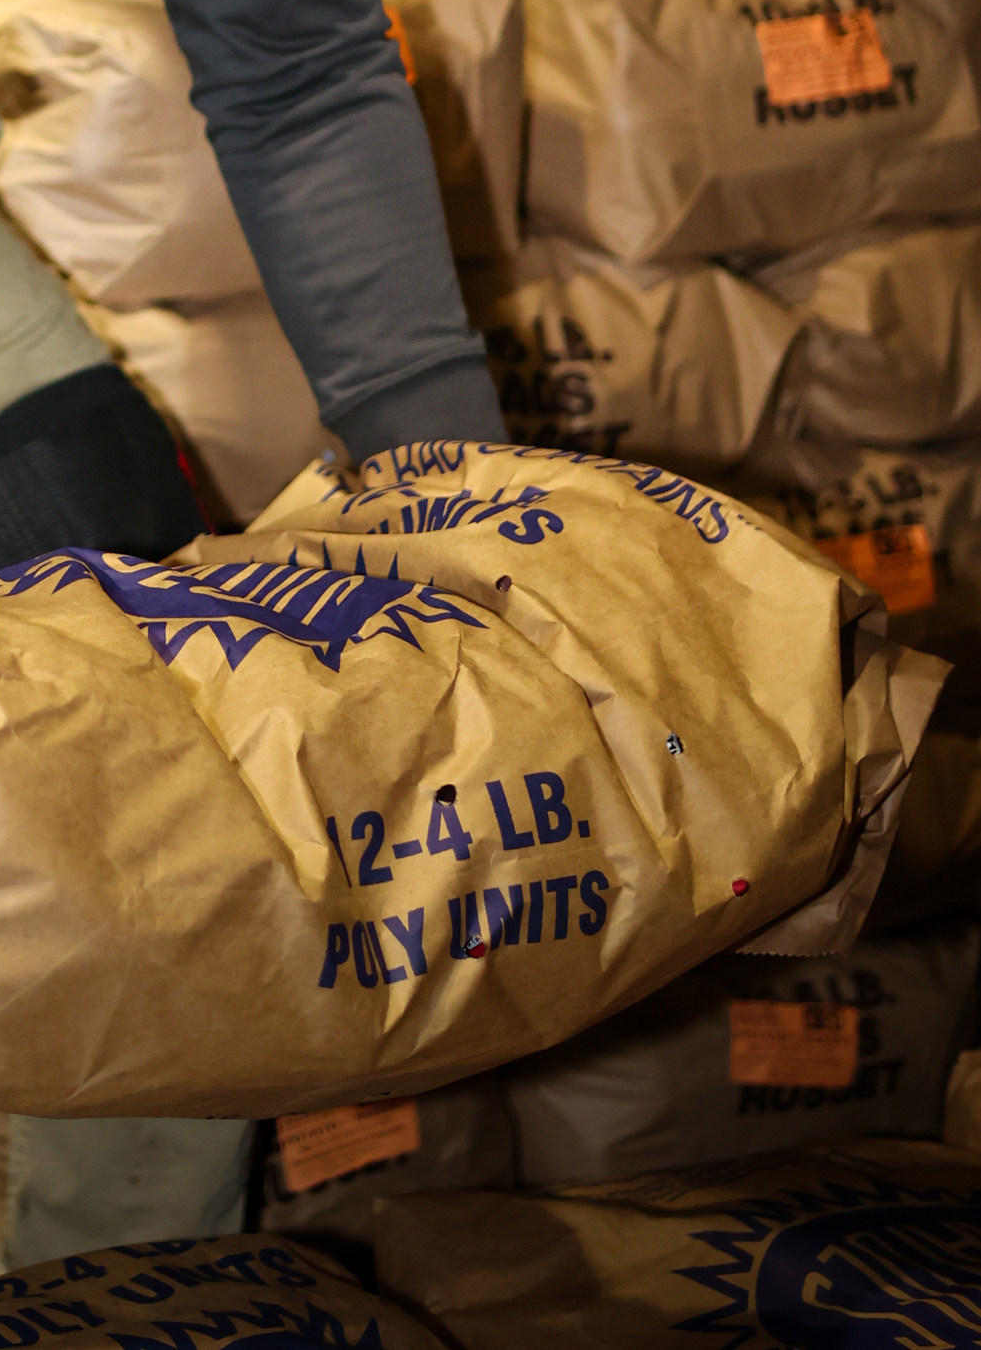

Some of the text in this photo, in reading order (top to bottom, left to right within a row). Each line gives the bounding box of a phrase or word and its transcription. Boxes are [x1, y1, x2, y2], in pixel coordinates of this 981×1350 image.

[326, 770, 591, 888] 12-4 LB.
[317, 870, 610, 989] POLY UNITS
